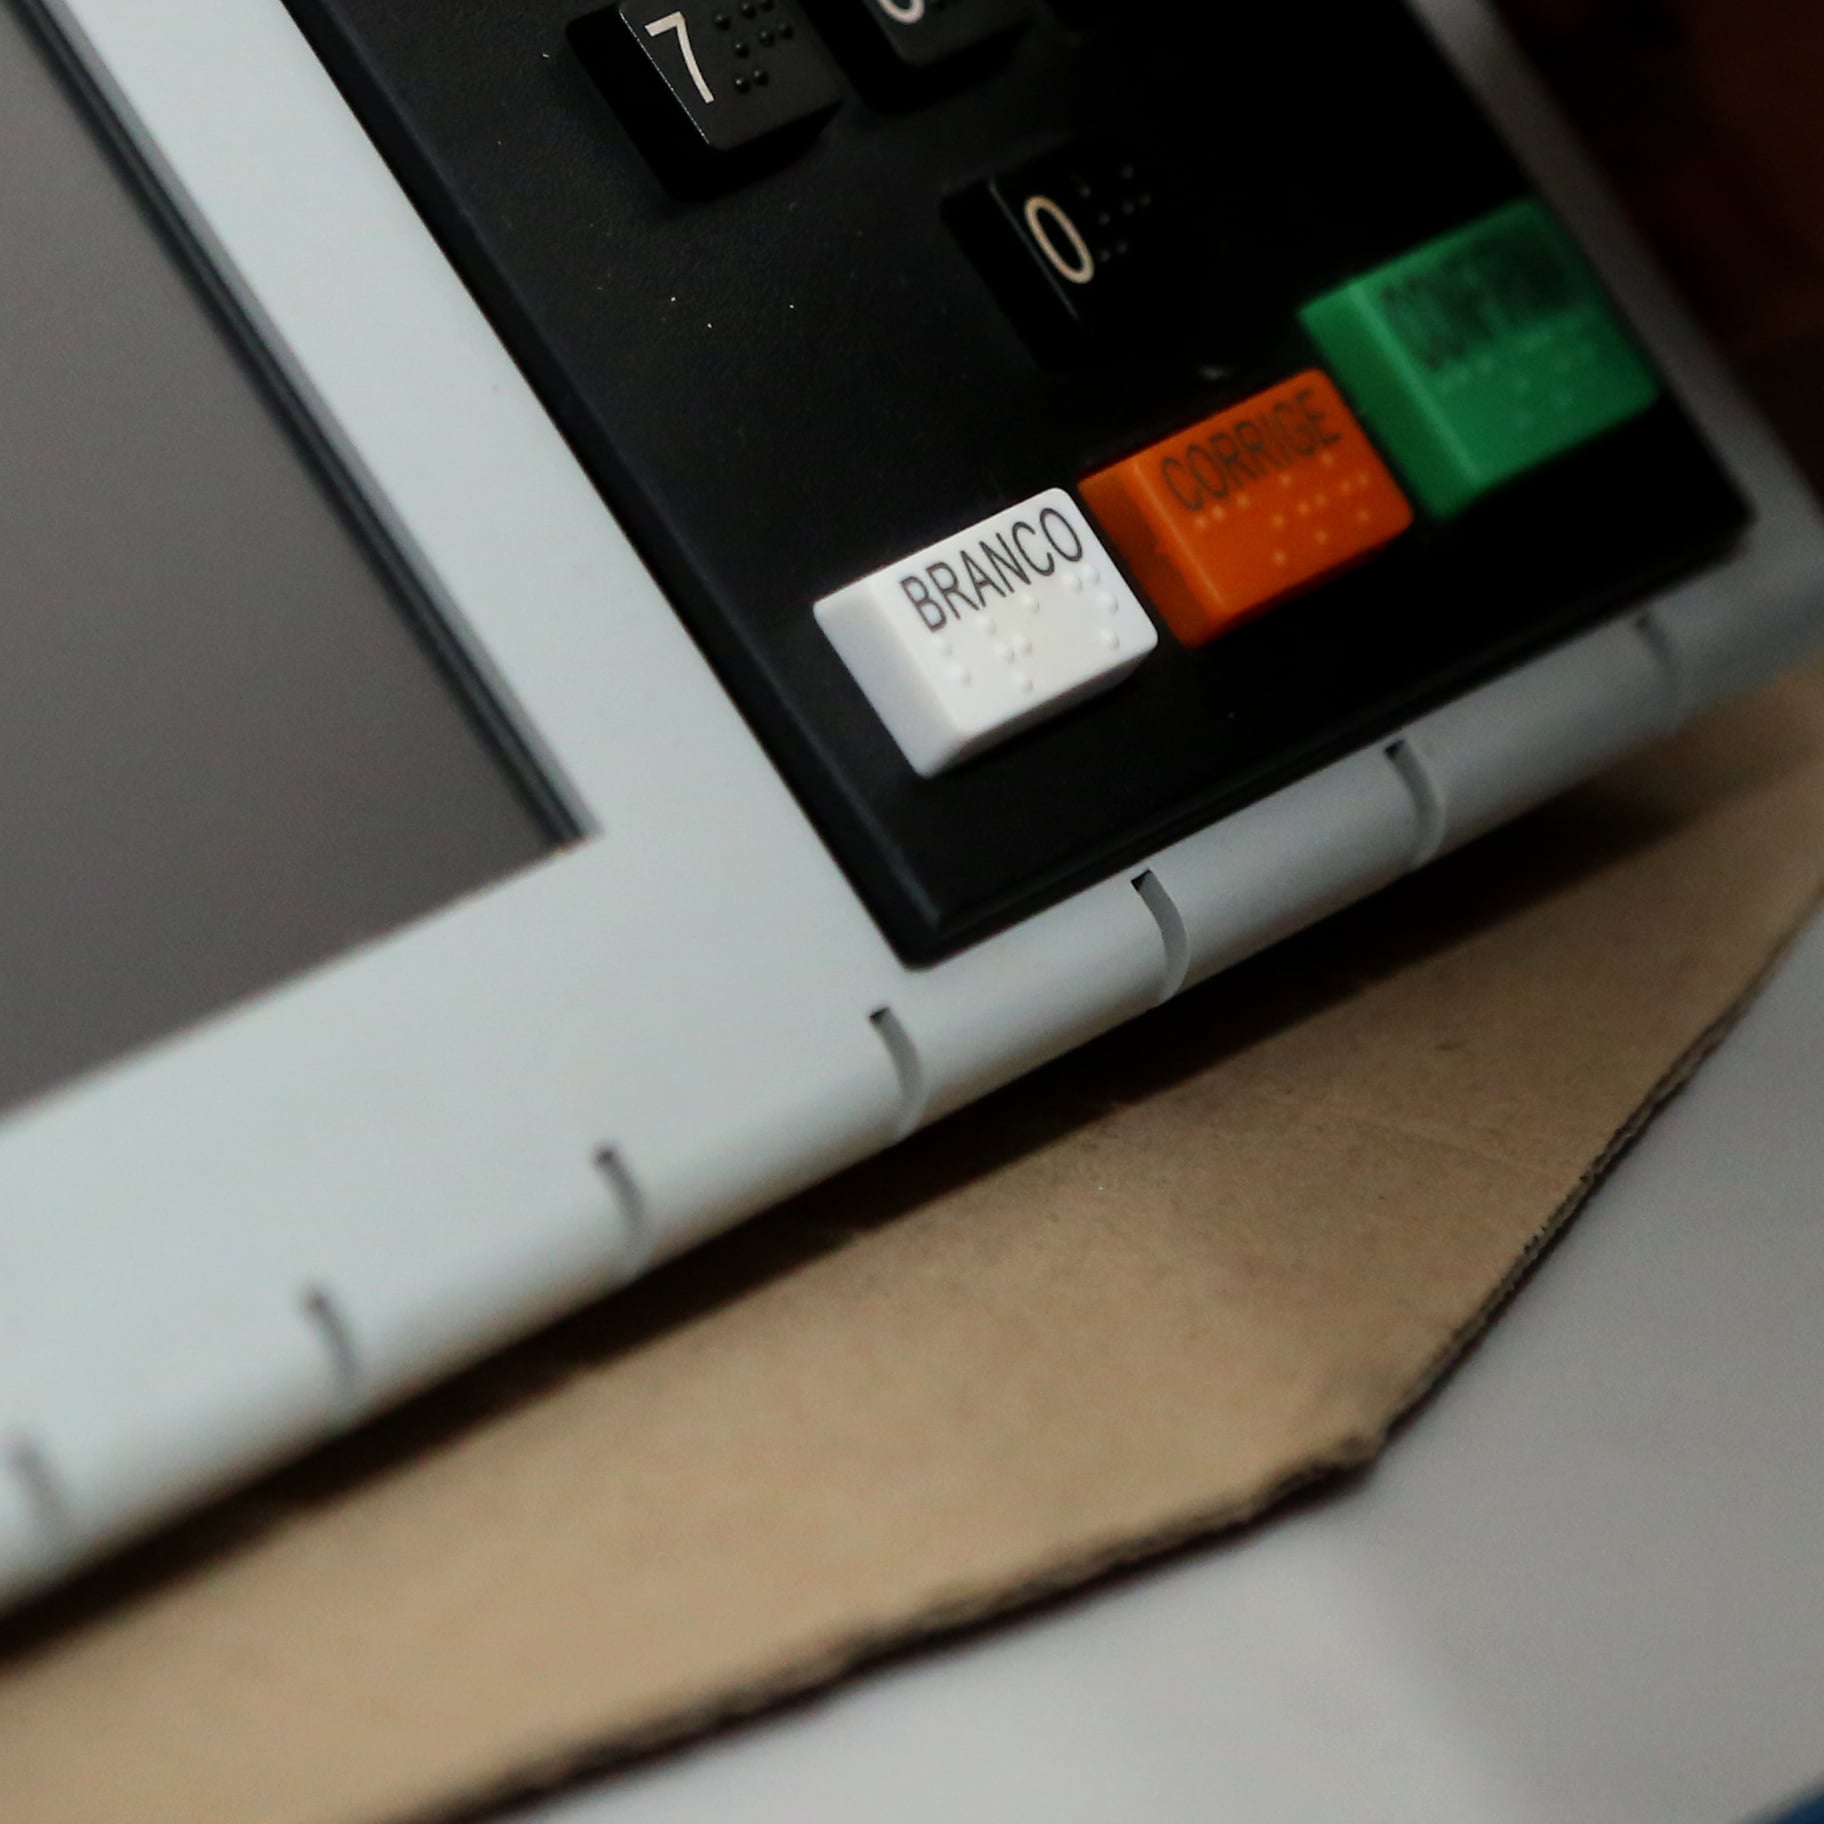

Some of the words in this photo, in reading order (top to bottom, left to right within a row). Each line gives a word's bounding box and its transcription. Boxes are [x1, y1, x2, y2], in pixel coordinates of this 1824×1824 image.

[645, 11, 714, 104] 7
[1025, 195, 1094, 284] 0
[900, 507, 1083, 633] BRANCO
[1161, 388, 1343, 512] CORRIGE
